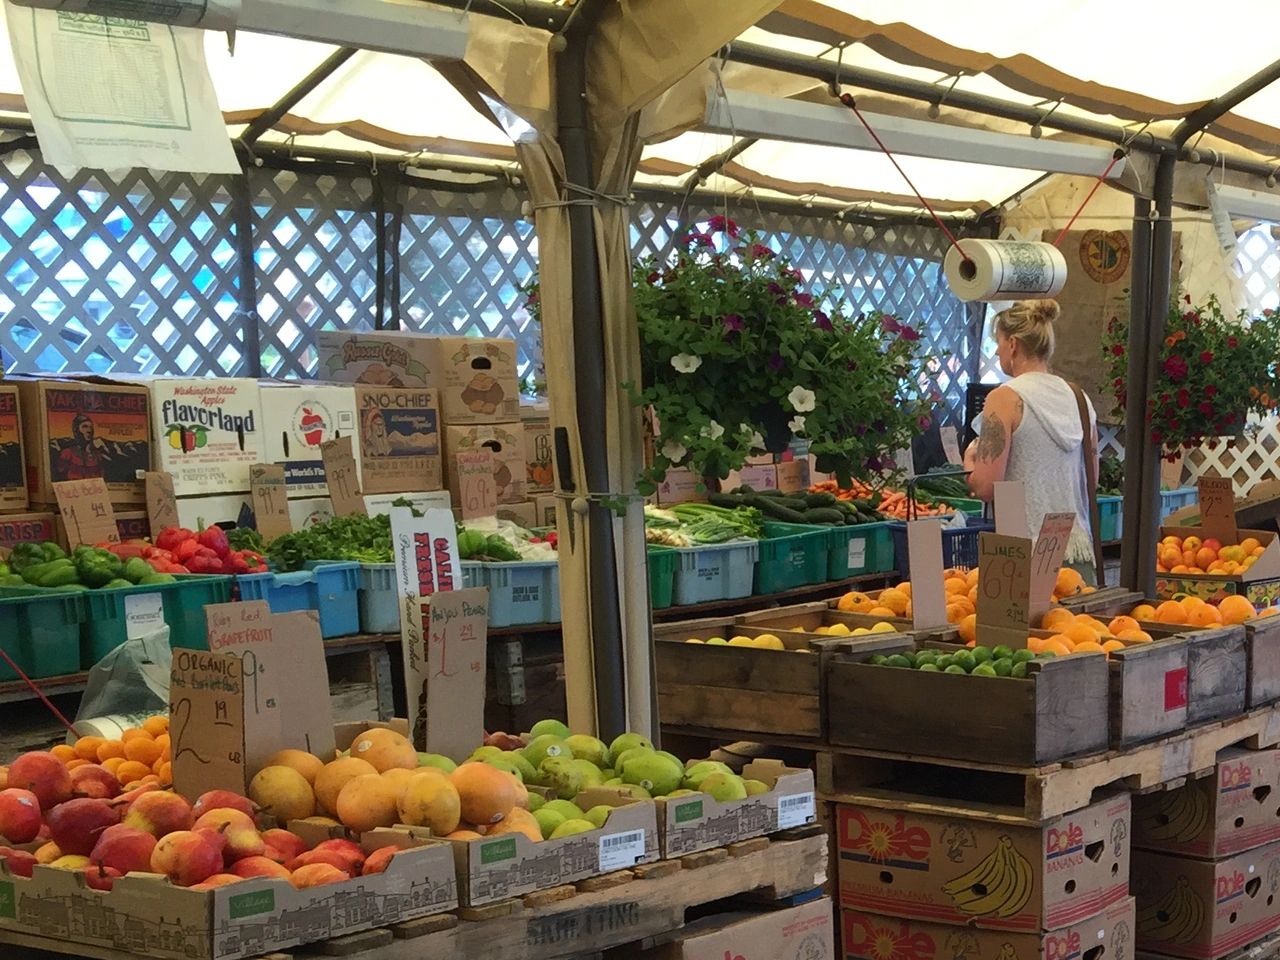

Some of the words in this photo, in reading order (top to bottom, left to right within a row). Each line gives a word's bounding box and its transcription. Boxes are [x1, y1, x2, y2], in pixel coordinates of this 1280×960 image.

[50, 391, 107, 411] YAKMA
[109, 396, 146, 412] CHIEF
[200, 396, 225, 407] Apples
[363, 393, 432, 408] SNO-CHIEF
[162, 399, 256, 432] flavorland
[399, 533, 410, 588] Premium
[981, 536, 1026, 560] LIMES
[241, 609, 260, 621] Red
[404, 587, 417, 628] Hand
[209, 627, 273, 649] GRAPEFRUIT
[408, 629, 420, 673] Packed
[178, 652, 239, 678] ORGANIC
[215, 701, 228, 720] 19
[1221, 762, 1252, 788] Dole
[838, 806, 931, 861] Dole
[1046, 822, 1083, 854] Dole
[1046, 854, 1084, 874] BANANAS
[1217, 870, 1245, 898] Dole
